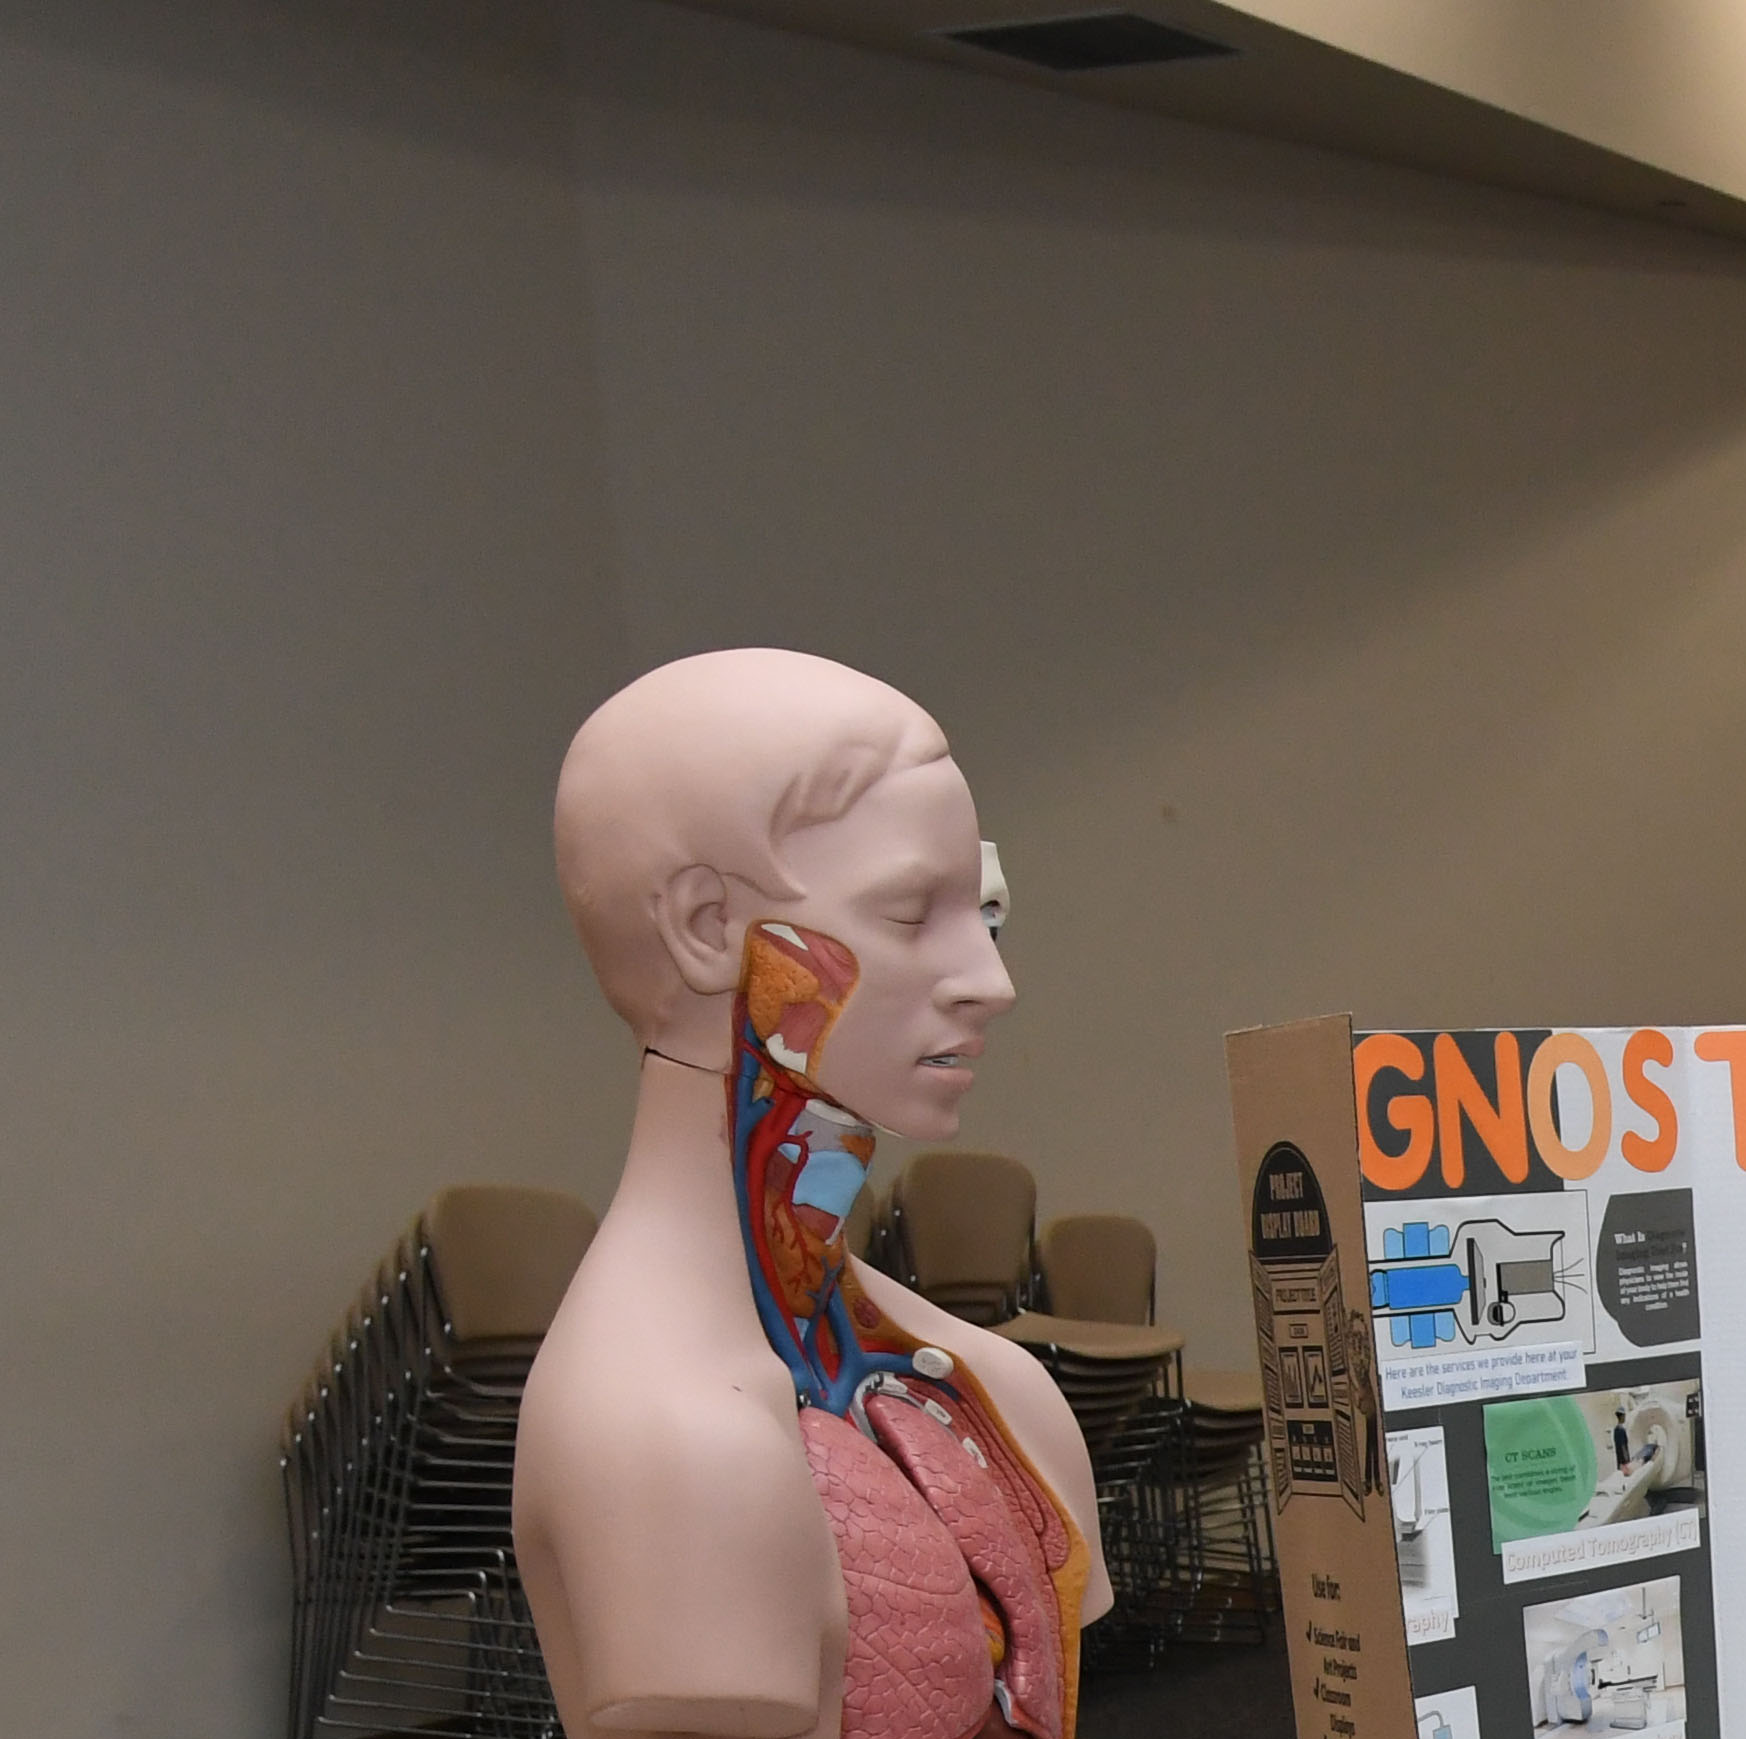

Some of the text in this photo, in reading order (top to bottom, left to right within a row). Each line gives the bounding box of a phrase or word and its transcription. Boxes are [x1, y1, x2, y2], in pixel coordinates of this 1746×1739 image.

[1385, 1349, 1578, 1380] Here are the services we provide here at your
[1400, 1368, 1567, 1399] Keesler Diagnostic Imaging Department
[1504, 1447, 1556, 1463] CT SCANS
[1506, 1519, 1698, 1573] Computed Tomography (CT)
